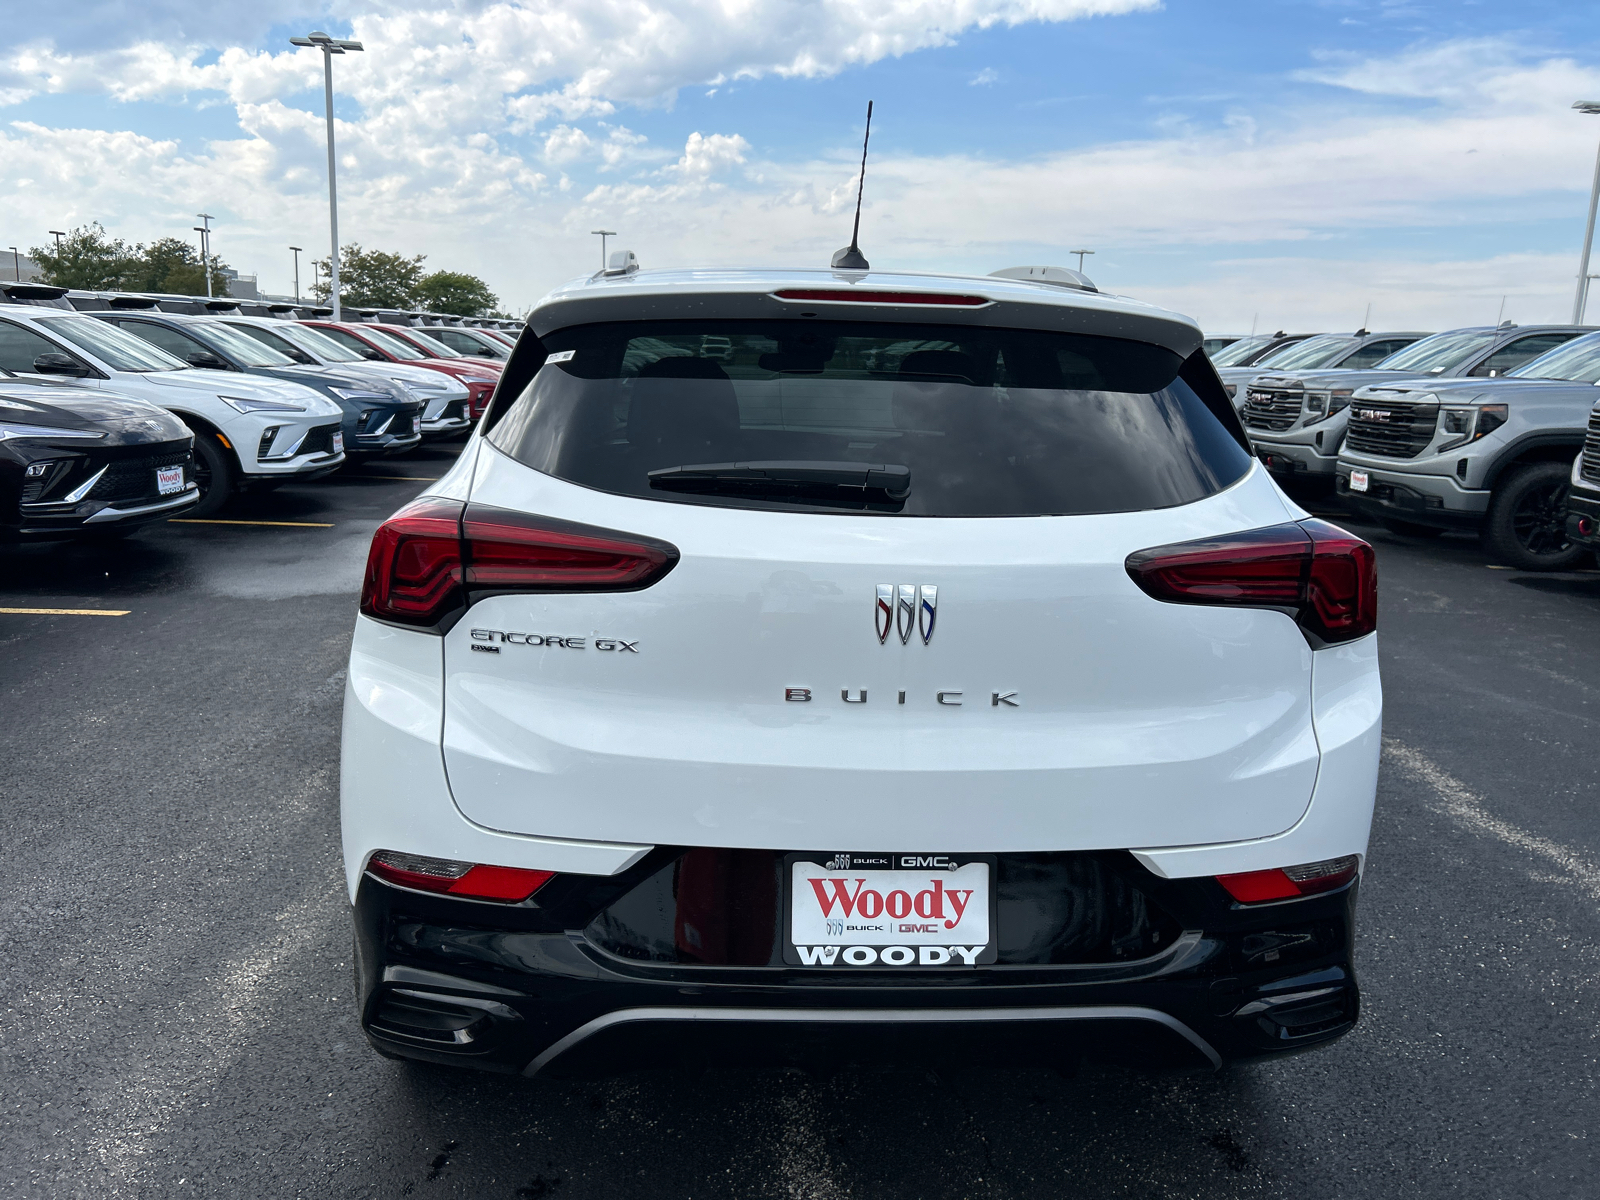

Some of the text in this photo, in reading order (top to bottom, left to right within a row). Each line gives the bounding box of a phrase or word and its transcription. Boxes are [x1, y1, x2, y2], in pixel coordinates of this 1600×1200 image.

[159, 471, 181, 483] Woody
[470, 628, 640, 654] ENCORE GX
[785, 686, 1020, 707] BUICK
[853, 856, 950, 868] BUICK GMC
[807, 878, 974, 930] Woody
[846, 924, 939, 933] BUICK GMC
[795, 946, 987, 966] WOODY
